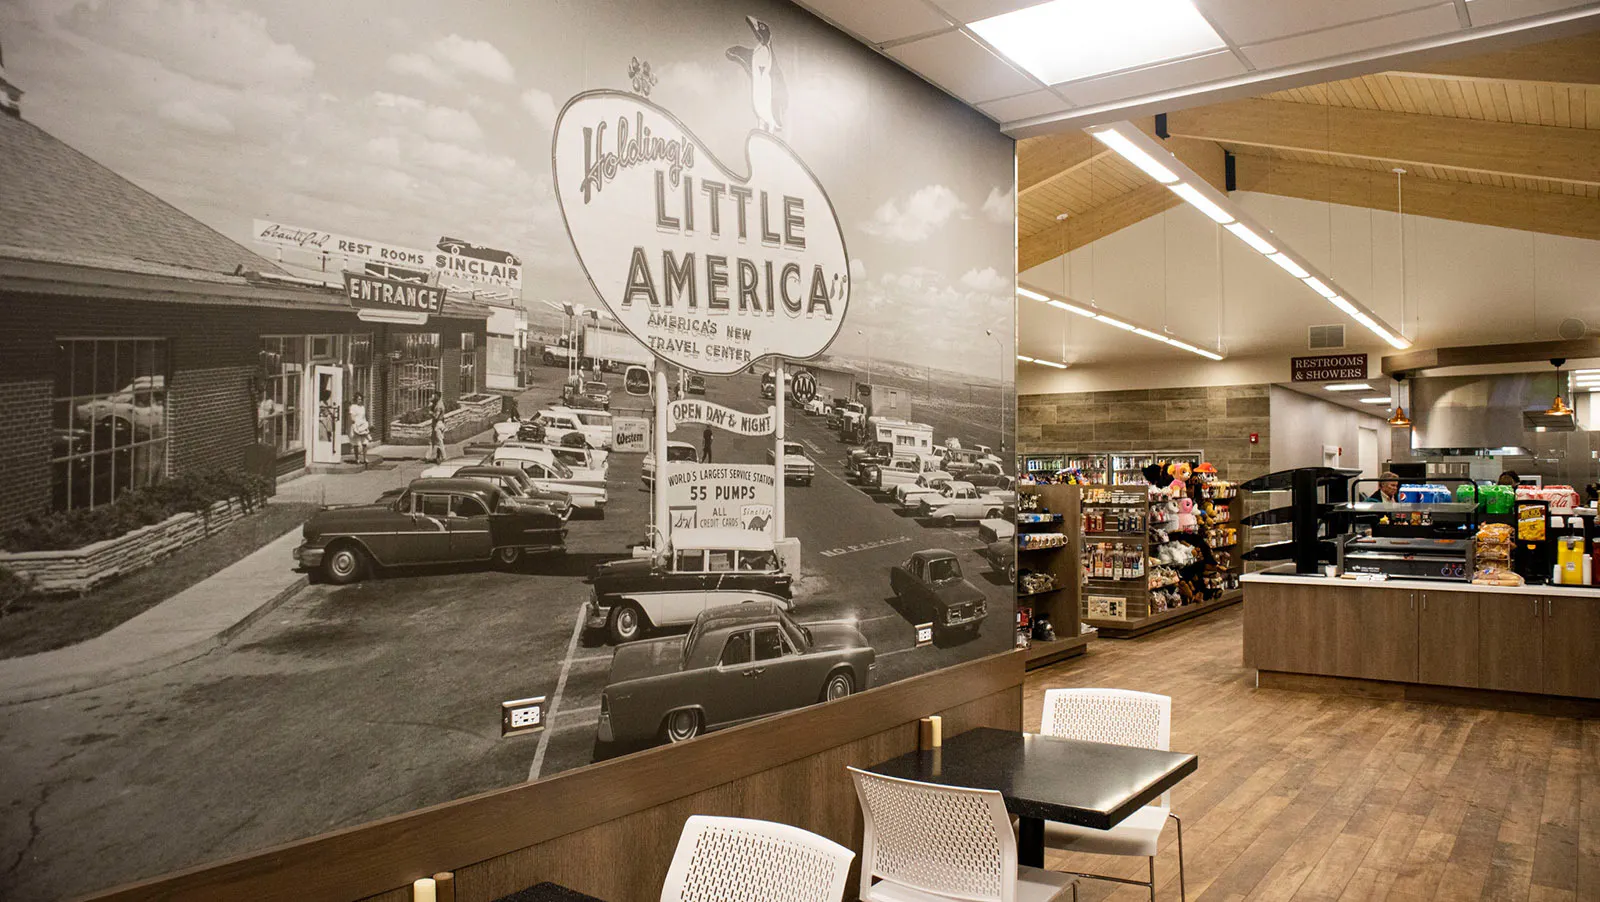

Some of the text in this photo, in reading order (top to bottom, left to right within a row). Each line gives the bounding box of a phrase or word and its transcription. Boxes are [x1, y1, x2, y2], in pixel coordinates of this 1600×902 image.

[579, 111, 695, 205] Holding's
[654, 169, 806, 250] LITTLE
[338, 239, 373, 255] REST
[380, 248, 425, 265] ROOMS
[435, 254, 518, 281] SINCLAIR
[349, 277, 438, 311] ENTRANCE
[622, 246, 833, 317] AMERICA
[647, 312, 752, 341] AMERICA'S NEW
[647, 335, 752, 361] TRAVEL CENTER
[1295, 356, 1364, 369] RESTROOMS
[1295, 368, 1362, 380] & SHOWERS
[795, 375, 814, 399] AAA
[672, 403, 771, 432] OPEN DAY & NIGHT
[668, 468, 775, 487] WORLD'S LARGEST SERVICE STATION
[690, 485, 756, 500] 55 PUMPS
[699, 517, 739, 528] CREDIT CARDS
[712, 507, 728, 516] ALL
[742, 507, 772, 516] Sinclair
